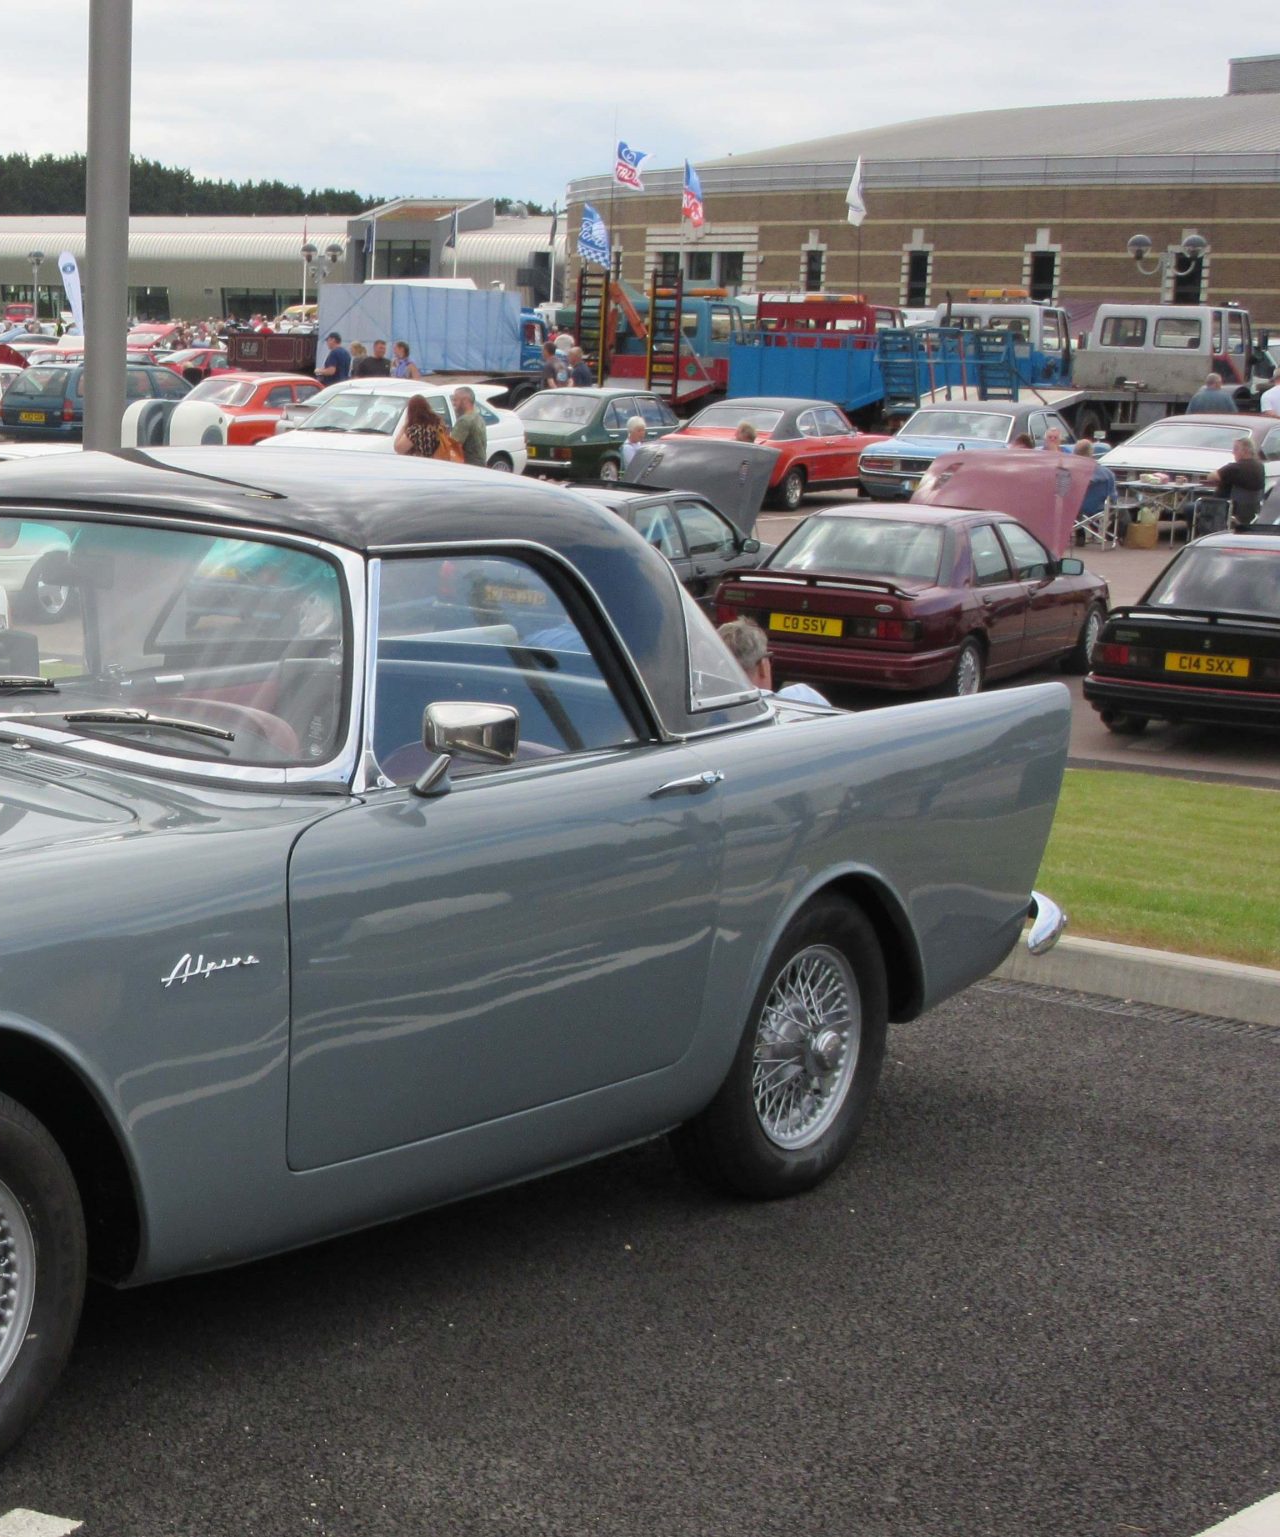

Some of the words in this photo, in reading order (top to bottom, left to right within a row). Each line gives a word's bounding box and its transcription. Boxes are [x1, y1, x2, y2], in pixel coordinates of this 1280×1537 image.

[802, 617, 827, 633] SSV
[1178, 655, 1201, 670] C14
[1205, 658, 1235, 673] SXX
[161, 953, 260, 988] Alpine
